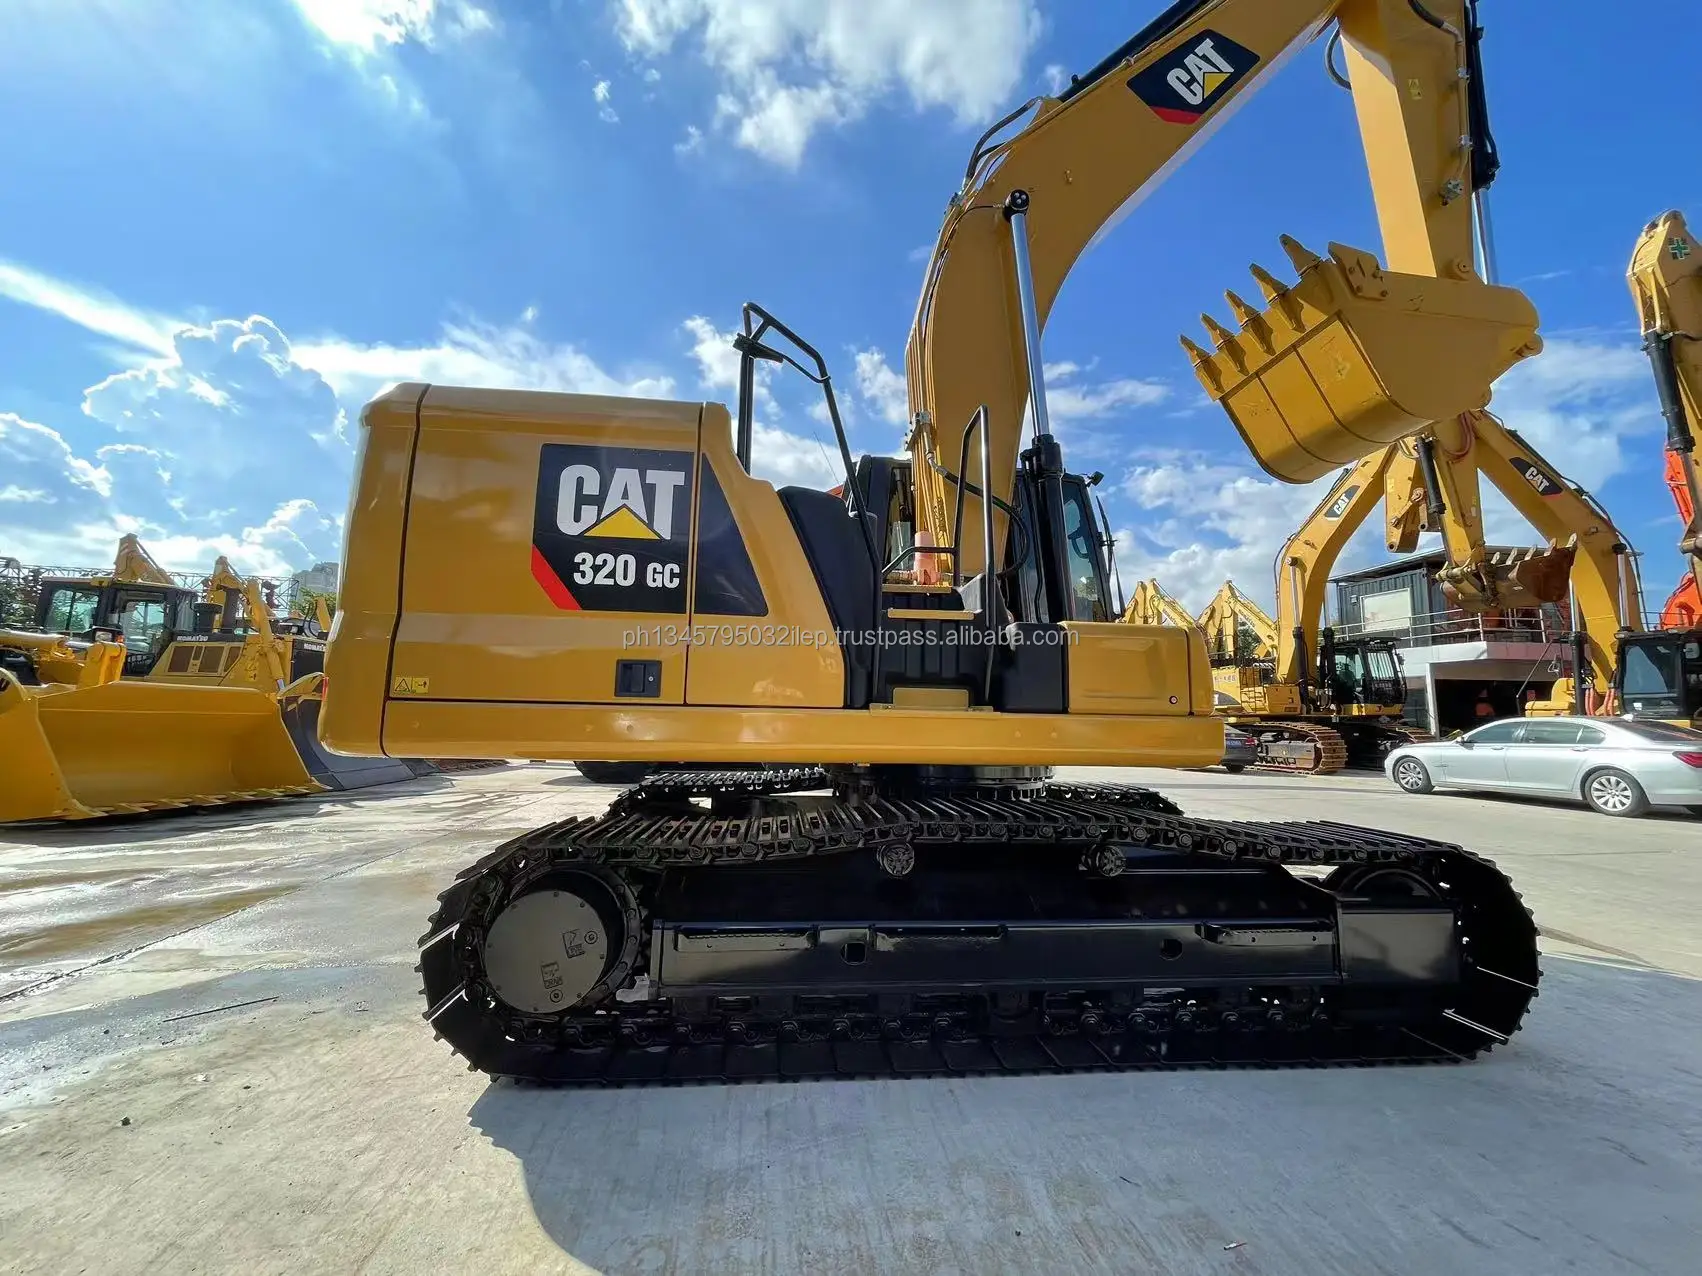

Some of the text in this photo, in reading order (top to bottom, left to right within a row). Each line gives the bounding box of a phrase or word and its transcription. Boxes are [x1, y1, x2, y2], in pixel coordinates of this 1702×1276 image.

[1166, 37, 1235, 105] CAT
[1525, 466, 1550, 492] CAT
[556, 464, 686, 540] CAT
[1333, 493, 1350, 515] CAT
[573, 552, 681, 589] 320 GC
[177, 634, 208, 642] KOMATSU
